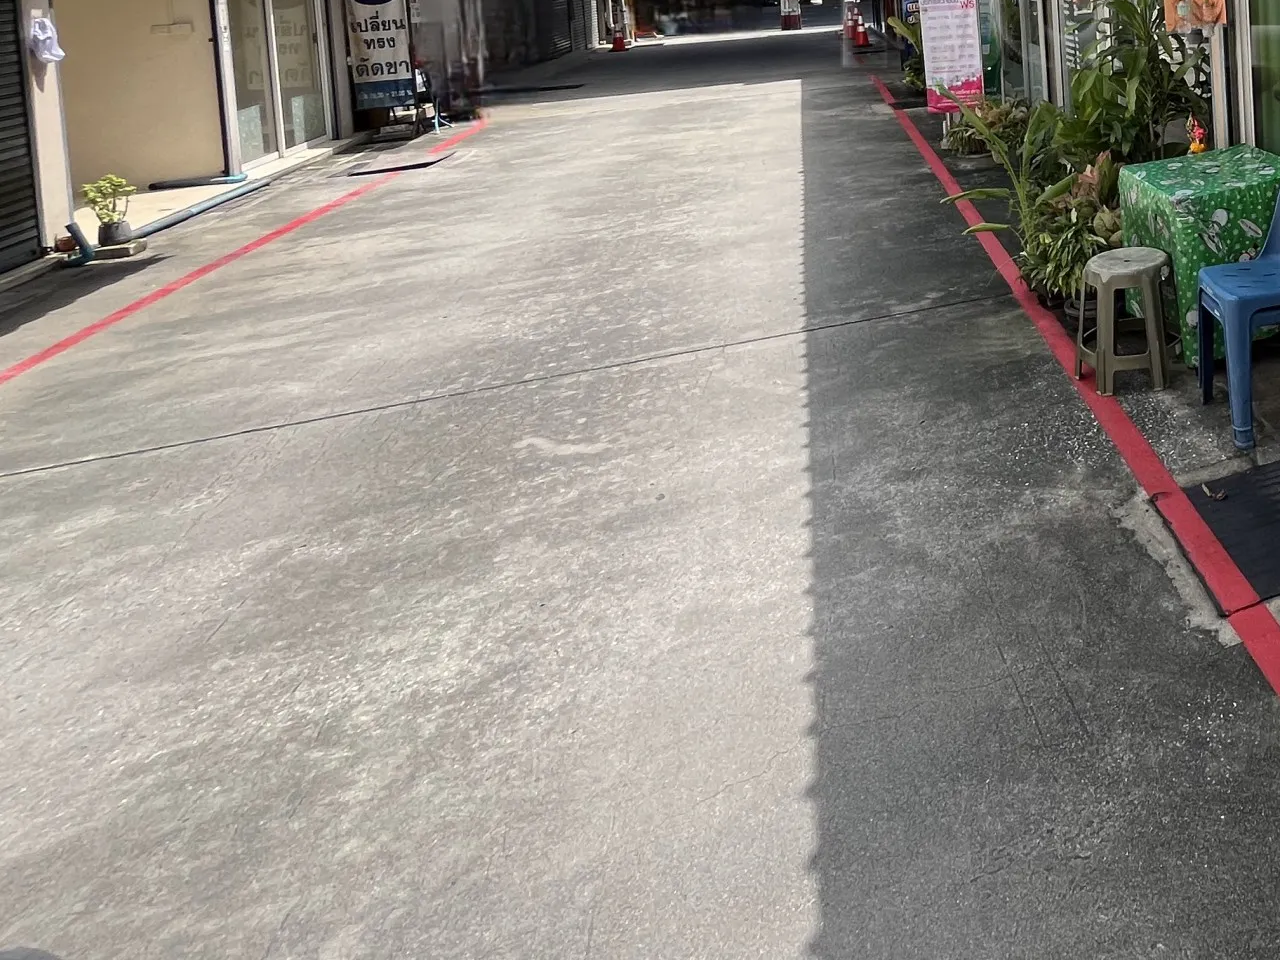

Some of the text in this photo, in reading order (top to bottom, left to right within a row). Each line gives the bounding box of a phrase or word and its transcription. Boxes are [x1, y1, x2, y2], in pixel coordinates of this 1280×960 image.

[350, 11, 406, 33] เปลี่ยน
[363, 36, 396, 50] ทรง
[355, 58, 410, 77] ตัดขา
